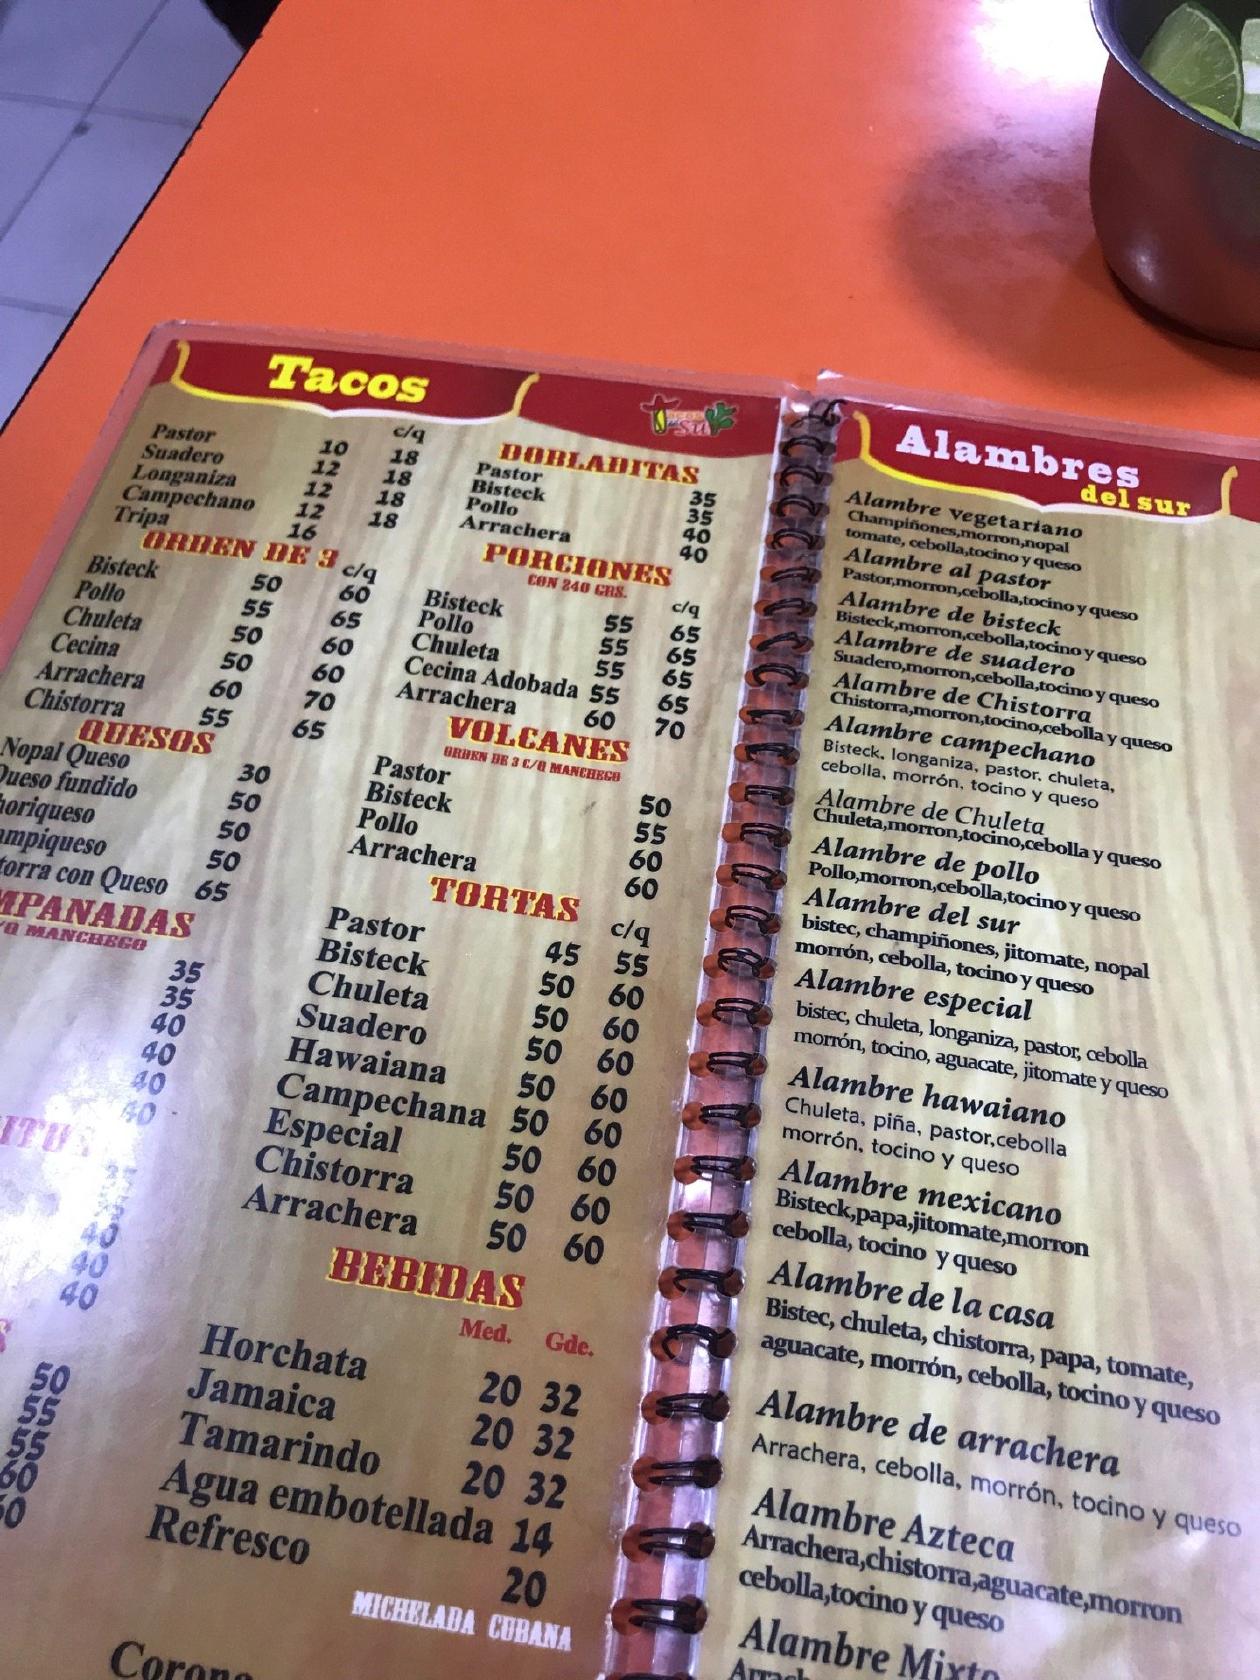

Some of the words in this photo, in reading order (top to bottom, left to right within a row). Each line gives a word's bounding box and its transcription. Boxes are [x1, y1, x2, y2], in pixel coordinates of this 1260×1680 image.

[267, 352, 430, 404] Tacos
[152, 423, 217, 444] Pastor
[319, 440, 348, 456] 10
[390, 449, 419, 465] 18
[392, 425, 425, 445] c/q
[896, 424, 1141, 488] Alambres
[142, 444, 224, 464] Suadero
[312, 460, 340, 476] 12
[383, 470, 412, 486] 18
[476, 462, 543, 482] Pastor
[689, 491, 717, 507] 35
[498, 442, 700, 485] DOBLADITAS
[113, 506, 170, 528] Tripa
[287, 524, 318, 541] 16
[122, 485, 255, 512] Campechano
[295, 502, 326, 520] 12
[368, 512, 399, 529] 18
[846, 490, 941, 517] Alambre
[948, 506, 1083, 539] vegetariano
[1080, 485, 1130, 509] del
[1136, 495, 1191, 517] sur
[141, 530, 256, 559] ORDEN
[262, 542, 310, 565] DE
[316, 548, 339, 568] 3
[342, 562, 377, 584] c/q
[481, 541, 673, 587] PORCIONES
[844, 547, 943, 575] Alambre
[949, 562, 973, 579] al
[978, 570, 1052, 591] pastor
[845, 527, 907, 548] tomate,
[1020, 555, 1031, 567] y
[1033, 556, 1082, 573] queso
[86, 555, 159, 580] Bisteck
[250, 574, 283, 593] 50
[339, 585, 371, 604] 60
[528, 574, 557, 588] CON
[423, 589, 505, 618] Bisteck
[604, 615, 635, 633] 55
[669, 625, 701, 643] 65
[671, 601, 700, 618] c/q
[839, 590, 940, 620] Alambre
[947, 606, 975, 623] de
[983, 610, 1062, 637] bisteck
[404, 656, 478, 684] Cecina
[481, 667, 580, 698] Adobada
[589, 686, 620, 705] 55
[658, 695, 690, 715] 65
[833, 672, 938, 701] Alambre
[942, 686, 971, 705] de
[977, 690, 1093, 723] Chistorra
[24, 687, 126, 717] Chistorra
[199, 707, 234, 727] 55
[292, 720, 327, 740] 65
[75, 720, 216, 755] QUESOS
[1, 736, 64, 761] Nopal
[66, 742, 131, 769] Queso
[237, 764, 271, 784] 30
[444, 746, 486, 762] ORDEN
[491, 752, 508, 766] DE
[511, 756, 520, 768] 3
[448, 716, 631, 762] VOLCANES
[824, 715, 934, 745] Alambre
[940, 730, 1096, 768] campechano
[372, 755, 452, 785] Pastor
[639, 794, 672, 817] 50
[820, 760, 888, 782] cebolla,
[970, 779, 1026, 797] tocino
[1031, 786, 1042, 802] y
[1049, 790, 1100, 810] queso
[891, 747, 979, 774] longaniza,
[1048, 772, 1116, 794] chuleta,
[816, 788, 918, 820] Alambre
[922, 802, 950, 822] de
[955, 806, 1046, 836] Chuleta
[348, 835, 478, 872] Arrachera
[624, 878, 658, 900] 60
[430, 875, 581, 922] TORTAS
[802, 887, 922, 920] Alambre
[929, 902, 969, 927] del
[976, 915, 1021, 936] sur
[325, 907, 426, 943] Pastor
[545, 942, 582, 966] 45
[614, 951, 649, 978] 55
[610, 919, 650, 948] c/q
[801, 914, 861, 938] bistec,
[865, 922, 1000, 960] champiñones,
[1003, 944, 1090, 973] jitomate,
[1094, 958, 1150, 981] nopal
[169, 960, 205, 983] 35
[316, 938, 430, 977] Bisteck
[538, 972, 575, 999] 50
[608, 985, 645, 1010] 60
[794, 968, 916, 1003] Alambre
[924, 987, 1033, 1022] especial
[151, 1013, 185, 1037] 40
[285, 1036, 447, 1085] Hawaiana
[518, 1072, 556, 1101] 50
[590, 1085, 628, 1114] 60
[788, 1065, 915, 1104] Alambre
[922, 1083, 1068, 1129] hawaiano
[784, 1096, 866, 1127] Chuleta,
[873, 1111, 922, 1134] piña,
[777, 1158, 909, 1202] Alambre
[917, 1183, 1063, 1227] mexicano
[326, 1247, 526, 1310] BEBIDAS
[767, 1259, 904, 1305] Alambre
[908, 1280, 945, 1313] de
[952, 1288, 983, 1317] la
[988, 1299, 1056, 1332] casa
[459, 1318, 513, 1344] Med.
[545, 1331, 595, 1357] Gde.
[764, 1298, 836, 1330] Bistec,
[840, 1310, 928, 1345] chuleta,
[933, 1326, 1036, 1364] chistorra,
[1040, 1344, 1102, 1375] papa,
[1106, 1354, 1195, 1391] tomate,
[30, 1361, 70, 1395] 50
[199, 1323, 369, 1381] Horchata
[479, 1371, 522, 1407] 20
[540, 1381, 583, 1417] 32
[17, 1393, 61, 1427] 55
[756, 1389, 901, 1436] Alambre
[908, 1413, 948, 1445] de
[957, 1427, 1122, 1478] arrachera
[178, 1410, 381, 1476] Tamarindo
[461, 1460, 505, 1498] 20
[524, 1471, 568, 1509] 32
[159, 1458, 259, 1507] Agua
[270, 1483, 495, 1545] embotellada
[510, 1517, 555, 1558] 14
[751, 1434, 867, 1474] Arrachera,
[874, 1456, 963, 1491] cebolla,
[970, 1472, 1064, 1510] morrón,
[1071, 1491, 1146, 1522] tocino
[1152, 1506, 1167, 1529] y
[1173, 1511, 1243, 1538] queso
[146, 1504, 311, 1566] Refresco
[501, 1566, 547, 1609] 20
[350, 1591, 477, 1636] MICHELADA
[488, 1614, 573, 1652] CUBANA
[739, 1617, 891, 1672] Alambre
